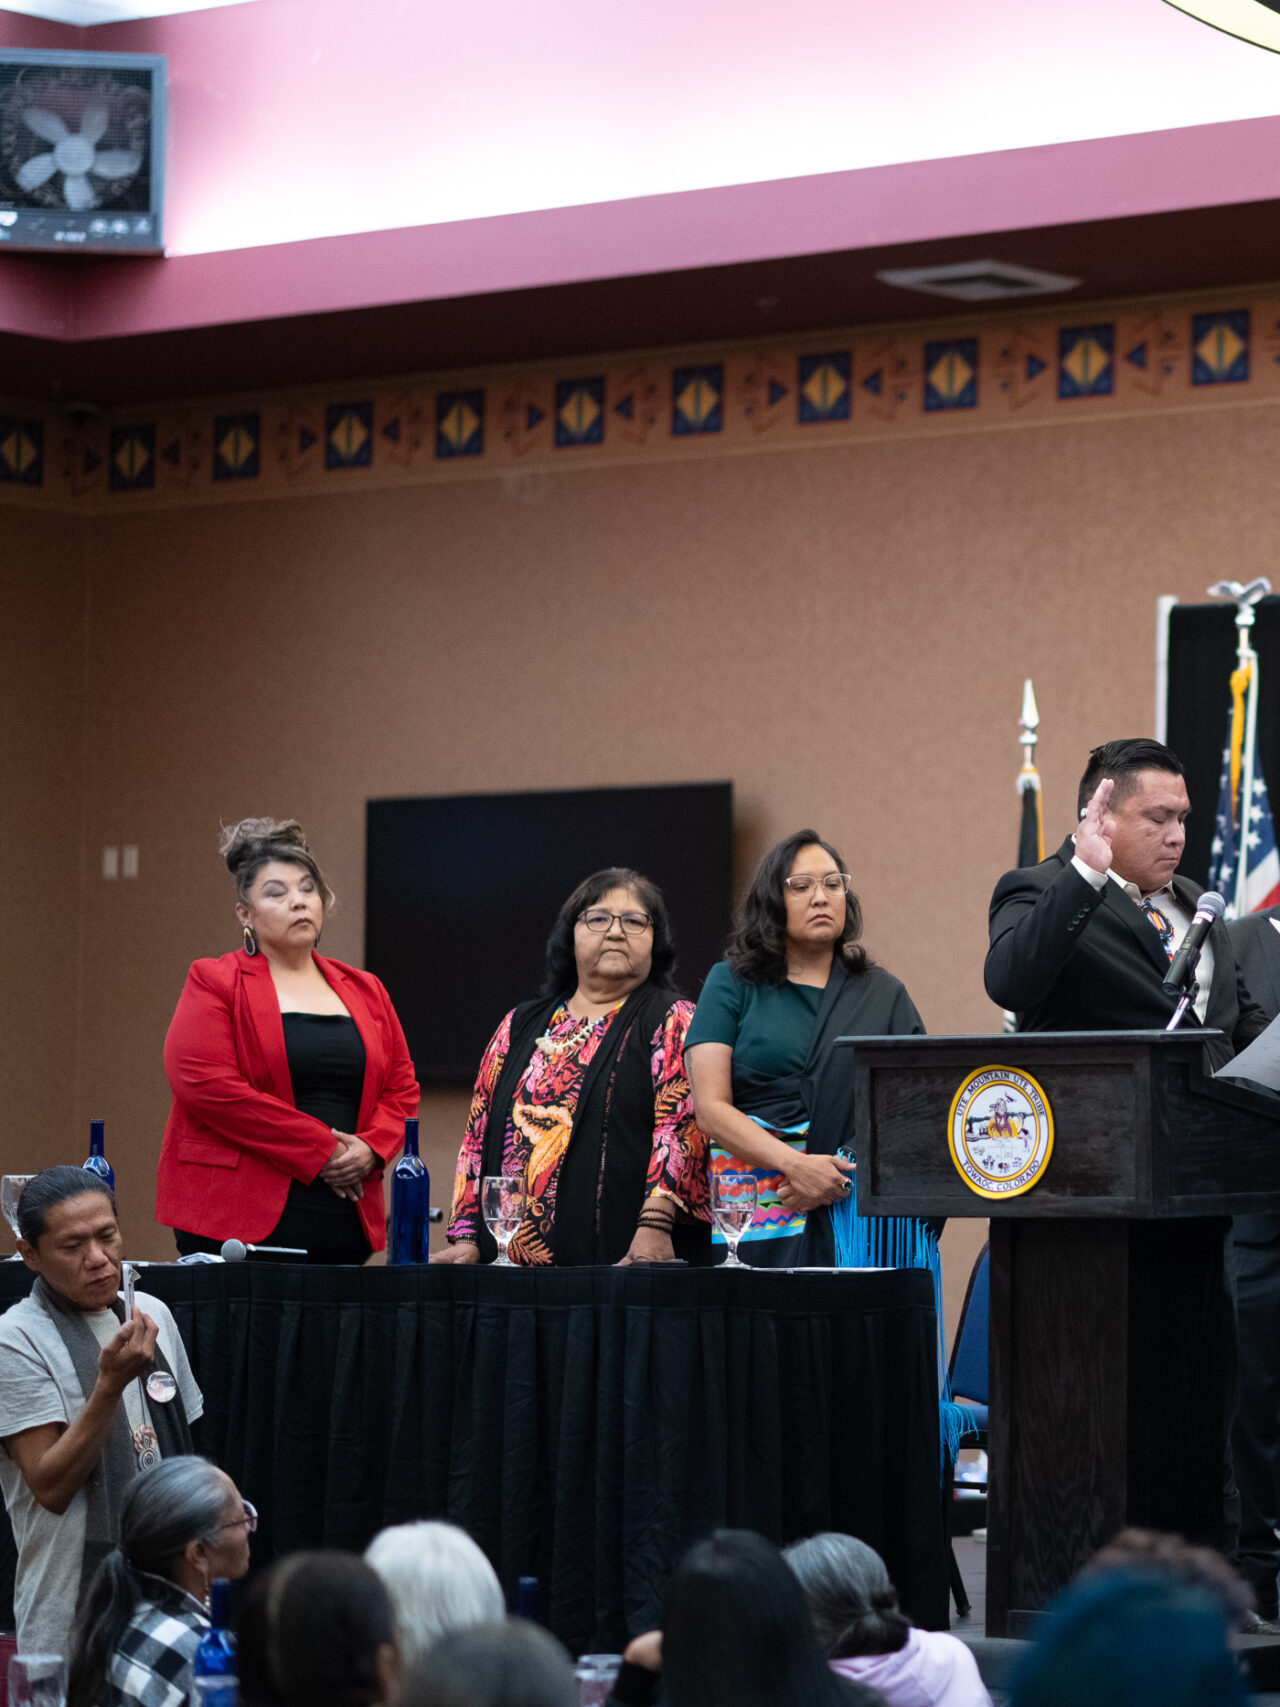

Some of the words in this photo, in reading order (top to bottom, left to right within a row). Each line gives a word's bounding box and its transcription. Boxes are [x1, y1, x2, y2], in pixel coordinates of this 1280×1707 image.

[957, 1097, 968, 1116] UTE
[968, 1071, 1010, 1095] MOUNTAIN
[1013, 1076, 1031, 1090] UTE
[1030, 1088, 1046, 1117] TRIBE
[962, 1160, 994, 1191] TOWAOC,
[996, 1159, 1040, 1191] COLORADO
